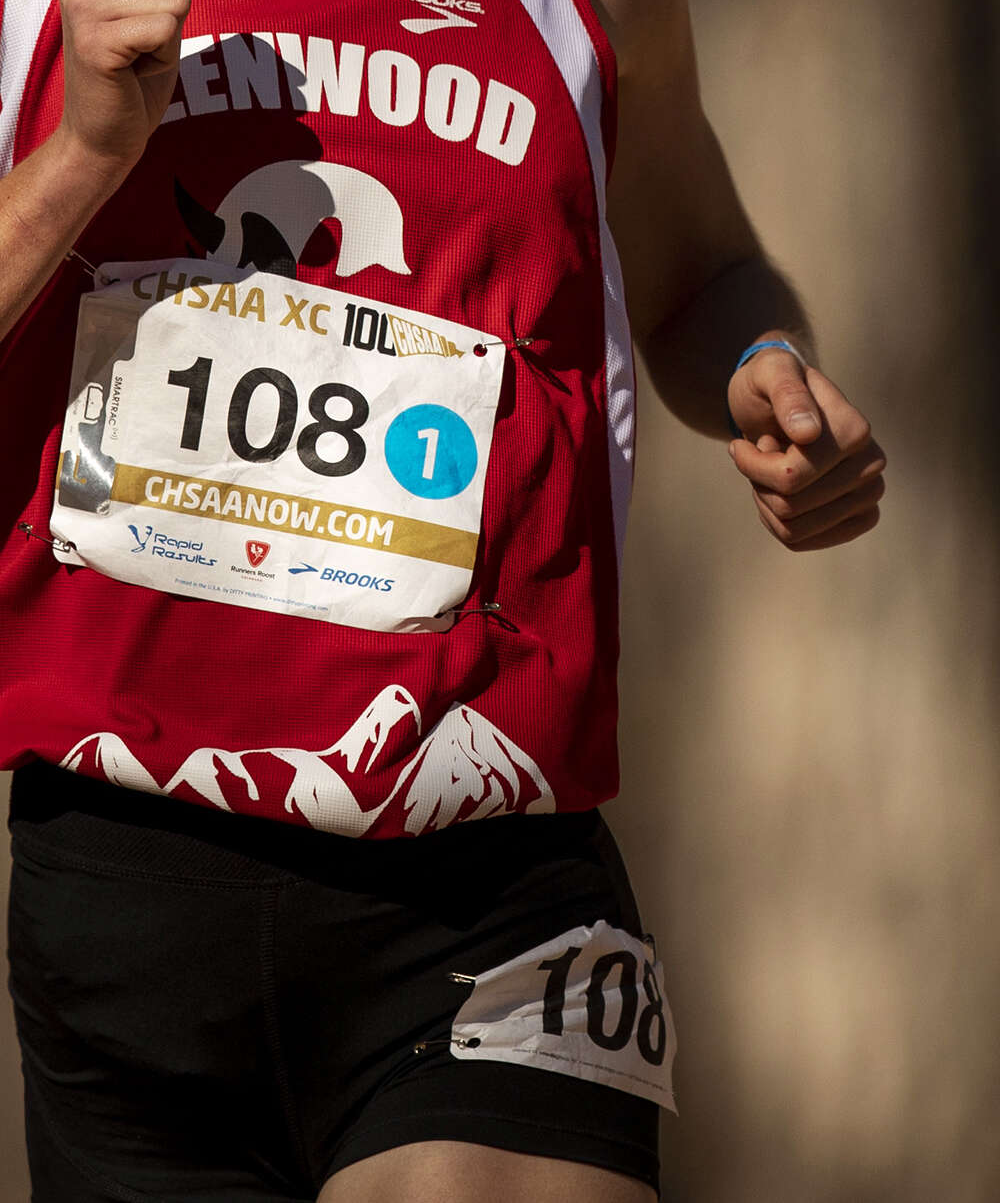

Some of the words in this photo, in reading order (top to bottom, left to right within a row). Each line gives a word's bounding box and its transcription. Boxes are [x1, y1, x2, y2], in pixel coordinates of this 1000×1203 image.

[132, 271, 267, 323] CHSAA
[279, 293, 331, 335] XC
[108, 376, 123, 427] SMARTRAC
[167, 356, 370, 477] 108
[416, 427, 440, 480] 1
[144, 475, 395, 546] CHSAANOW.COM
[151, 546, 218, 567] Results
[153, 533, 204, 551] Rapid
[230, 564, 256, 576] Runners
[257, 569, 276, 580] Roost
[319, 567, 396, 593] BROOKS
[536, 946, 666, 1065] 108
